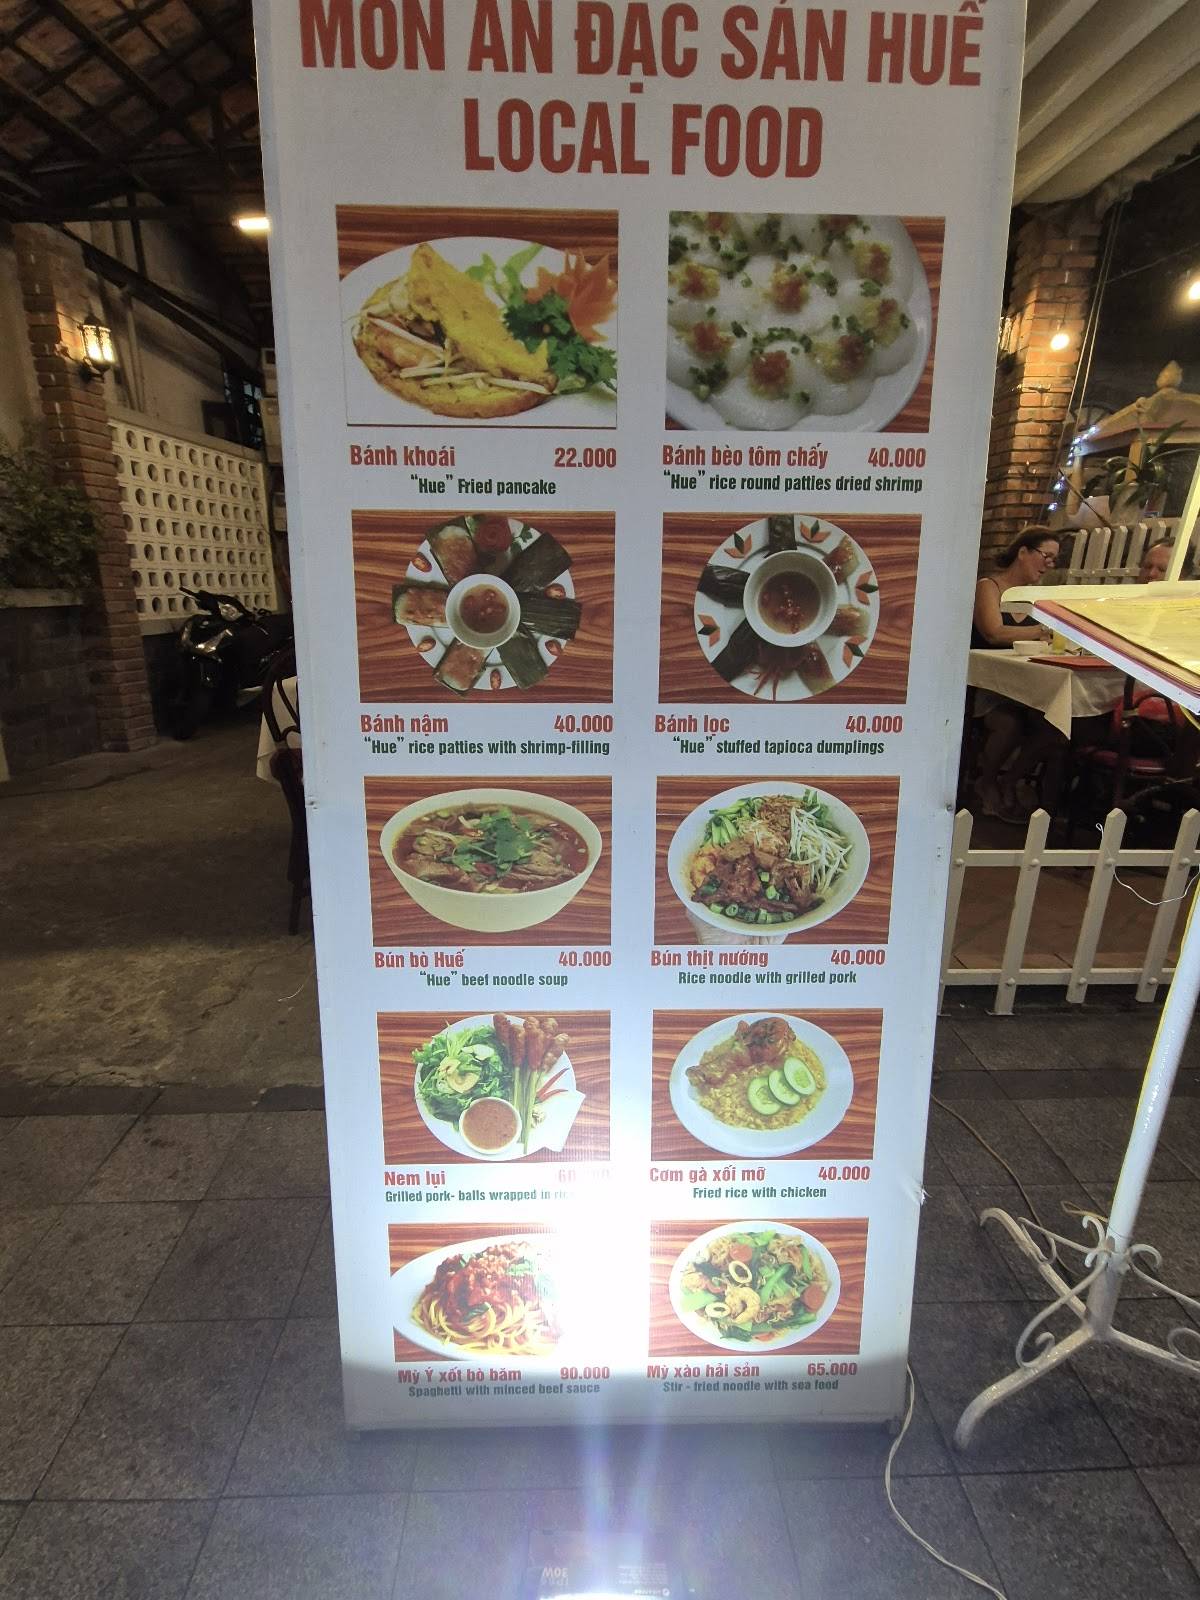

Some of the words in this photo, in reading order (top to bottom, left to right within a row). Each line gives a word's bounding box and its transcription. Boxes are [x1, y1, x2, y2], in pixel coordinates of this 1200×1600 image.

[464, 98, 649, 174] LOCAL
[671, 104, 823, 178] FOOD
[350, 444, 397, 465] Bánh
[404, 445, 455, 466] khoái
[554, 447, 617, 468] 22.000
[662, 444, 705, 466] Bánh
[712, 445, 742, 466] bèo
[749, 445, 780, 466] tôm
[868, 447, 926, 467] 40.000
[458, 478, 492, 494] Fried
[497, 479, 556, 495] pancake
[709, 474, 736, 490] rice
[740, 475, 780, 490] round
[785, 475, 831, 492] patties
[836, 476, 871, 491] dried
[875, 476, 922, 493] shrimp
[360, 714, 404, 732] Bánh
[411, 714, 448, 736] nậm
[554, 715, 613, 733] 40.000
[655, 714, 697, 733] Bánh
[704, 715, 729, 736] lọc
[846, 715, 903, 733] 40.000
[409, 740, 434, 754] rice
[439, 740, 483, 755] patties
[488, 740, 516, 753] with
[521, 740, 610, 755] shrimp-filling
[717, 740, 760, 754] stuffed
[765, 740, 813, 755] tapioca
[817, 740, 884, 755] dumplings
[374, 951, 404, 968] Bún
[410, 952, 428, 967] bò
[435, 949, 465, 968] Huế
[559, 951, 612, 966] 40.000
[651, 950, 681, 966] Bún
[687, 950, 713, 969] thịt
[719, 950, 768, 967] nướng
[831, 949, 885, 965] 40.000
[462, 974, 489, 986] beef
[493, 974, 534, 986] noodle
[539, 975, 568, 987] soup
[679, 972, 705, 984] Rice
[710, 972, 751, 984] noodle
[756, 972, 781, 984] with
[786, 971, 825, 984] grilled
[829, 971, 857, 984] pork
[384, 1171, 420, 1186] Nem
[426, 1171, 446, 1188] lụi
[650, 1168, 683, 1182] Cơm
[689, 1167, 707, 1183] gà
[713, 1165, 736, 1182] xối
[742, 1168, 766, 1181] mỡ
[819, 1167, 870, 1181] 40.000
[385, 1191, 422, 1203] Grilled
[426, 1190, 454, 1203] pork-
[458, 1190, 485, 1201] balls
[490, 1189, 536, 1201] wrapped
[541, 1189, 550, 1200] in
[693, 1188, 721, 1199] Fried
[725, 1188, 748, 1198] rice
[752, 1187, 776, 1198] with
[781, 1187, 827, 1198] chicken
[425, 1367, 433, 1383] Ý
[467, 1368, 484, 1382] bò
[490, 1368, 521, 1381] băm
[560, 1367, 610, 1380] 90.000
[674, 1365, 700, 1378] xào
[706, 1364, 728, 1378] hải
[734, 1363, 759, 1377] sản
[808, 1363, 857, 1376] 65.000
[408, 1385, 461, 1398] Spaghetti
[466, 1385, 489, 1396] with
[494, 1385, 535, 1395] minced
[539, 1384, 563, 1394] beef
[566, 1384, 600, 1393] sauce
[663, 1381, 682, 1392] Stir
[694, 1381, 719, 1392] fried
[723, 1380, 760, 1391] noodle
[765, 1380, 788, 1391] with
[792, 1380, 811, 1390] sea
[814, 1379, 838, 1390] food
